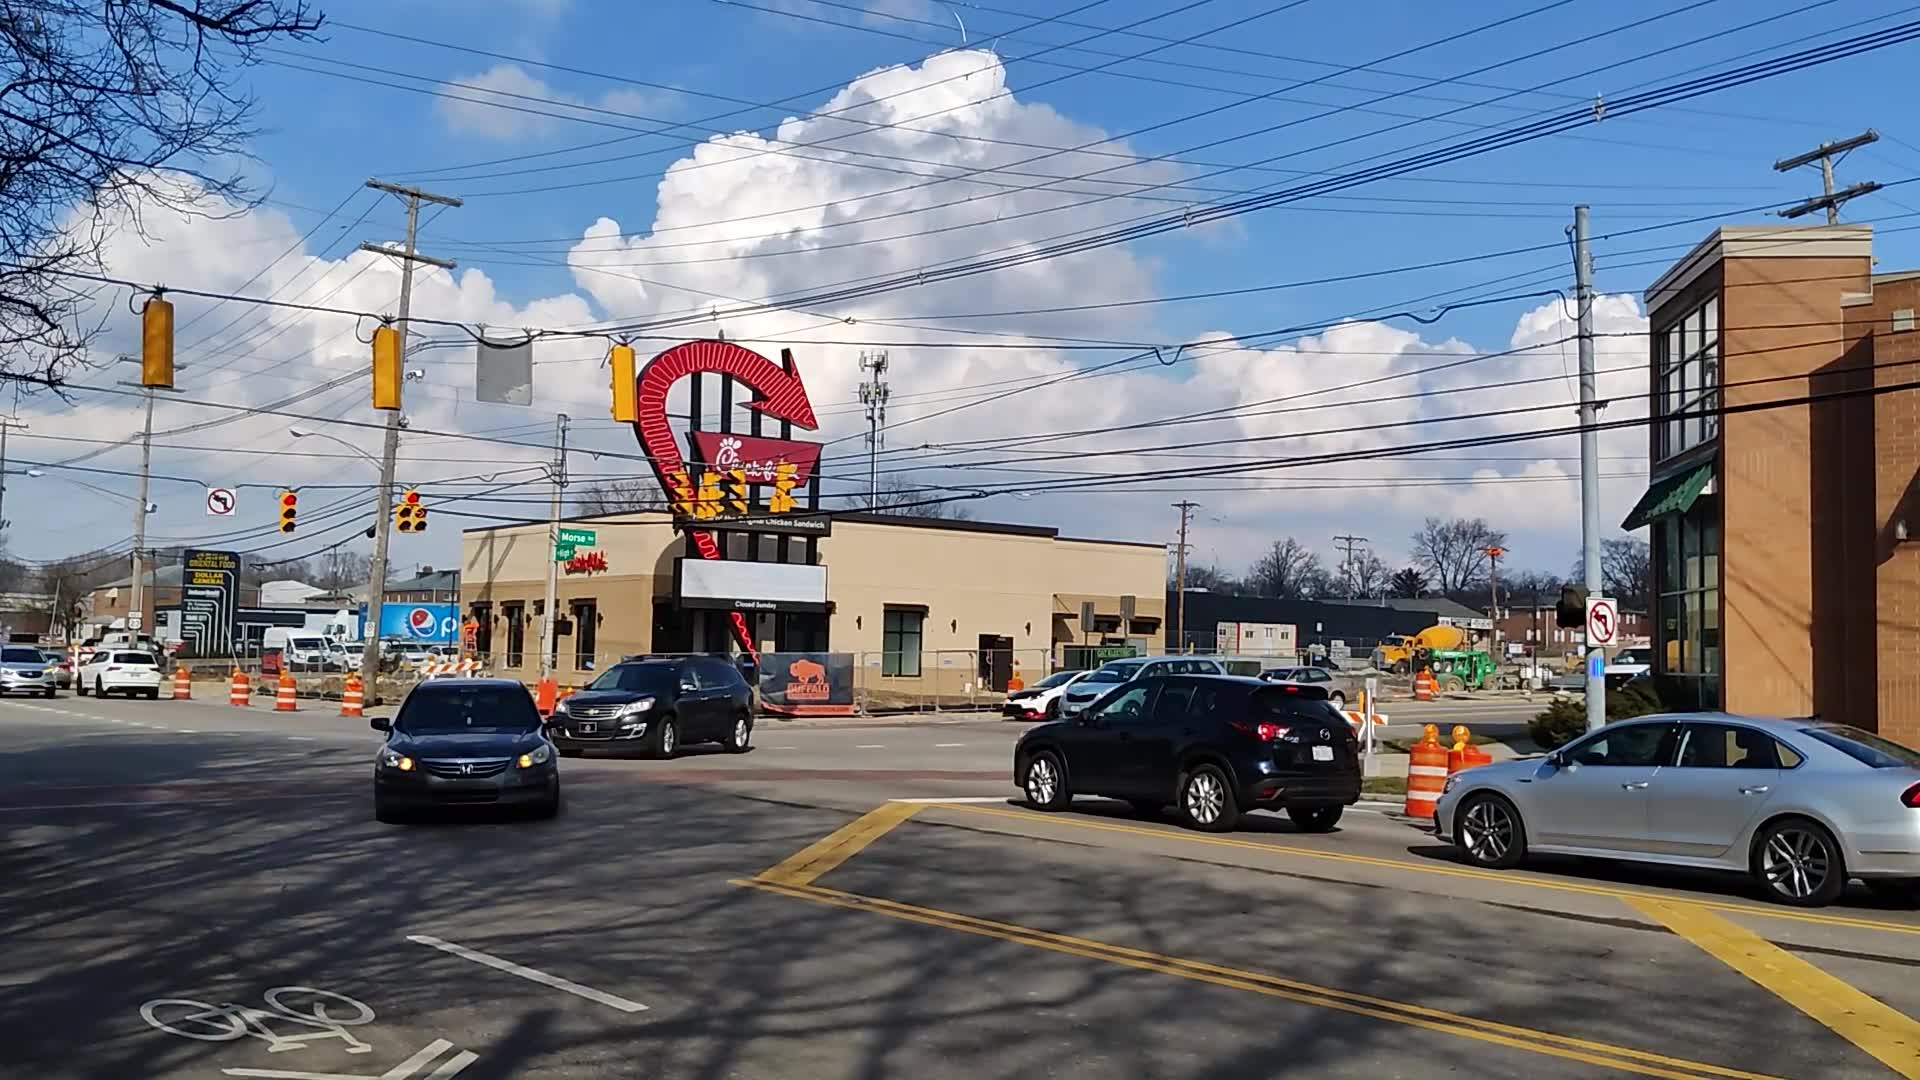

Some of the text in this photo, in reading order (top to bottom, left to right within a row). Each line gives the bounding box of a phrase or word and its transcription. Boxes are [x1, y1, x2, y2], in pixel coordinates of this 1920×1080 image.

[765, 518, 793, 527] Chicken
[793, 519, 825, 529] Sandwich
[561, 533, 586, 543] Morse
[189, 559, 236, 569] ORIENTAL FOOD
[195, 571, 224, 579] DOLLAR
[735, 600, 777, 610] Closed Sunday
[789, 684, 829, 694] BUFFALO
